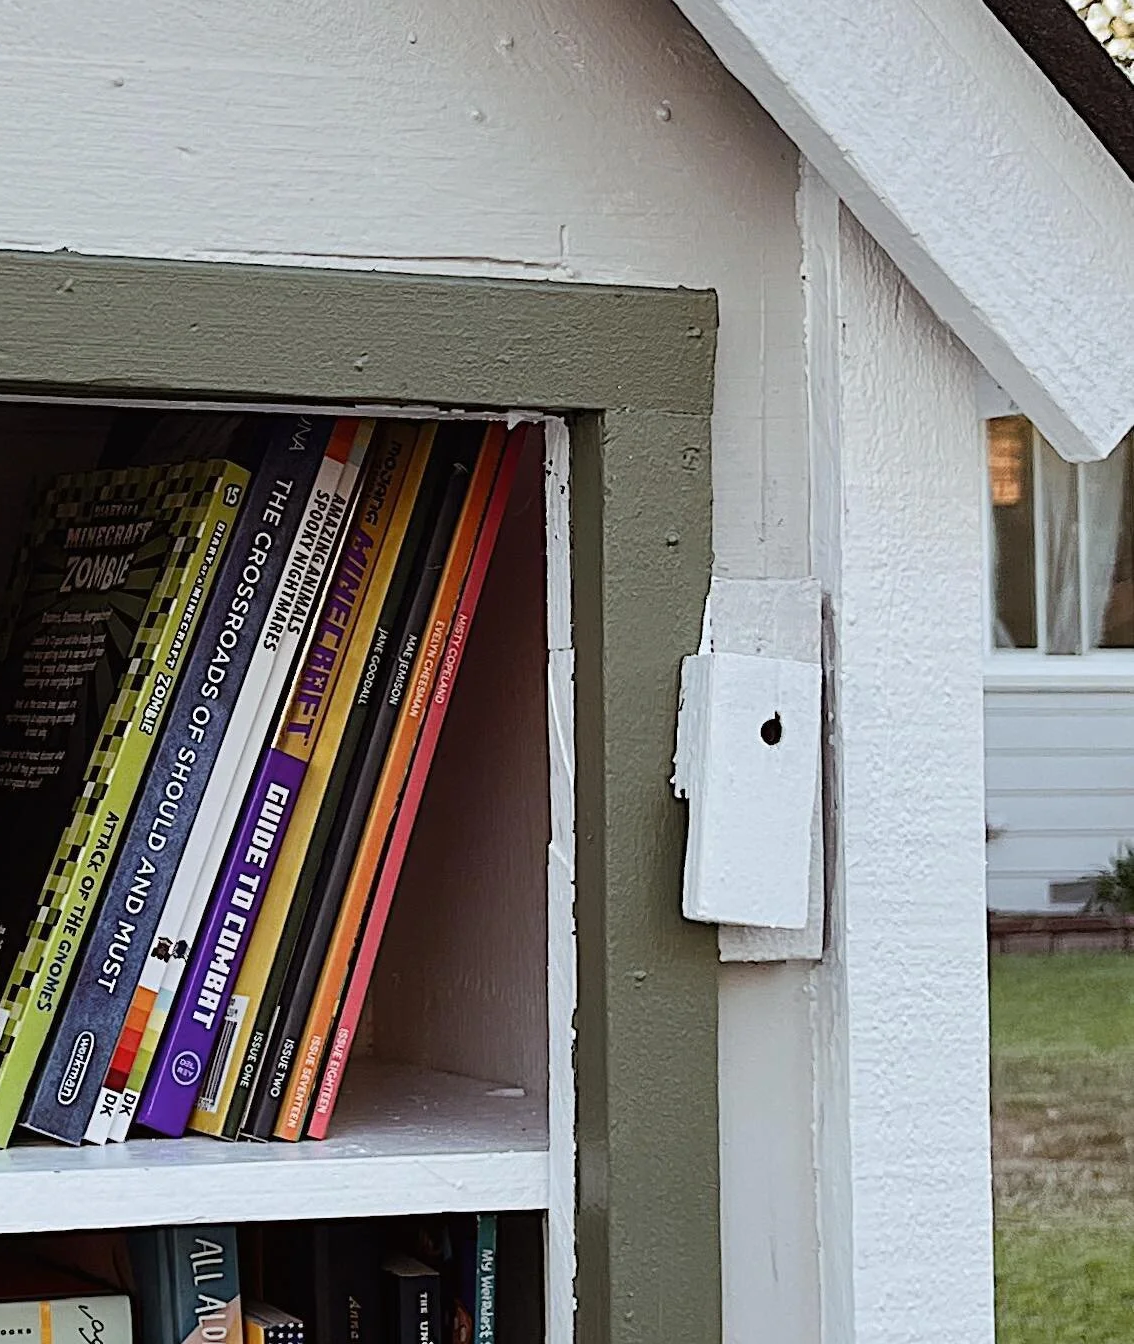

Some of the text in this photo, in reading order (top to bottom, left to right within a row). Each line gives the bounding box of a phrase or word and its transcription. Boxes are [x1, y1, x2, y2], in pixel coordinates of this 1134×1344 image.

[260, 488, 330, 653] SPOOKY NIGHTMARES
[284, 493, 346, 635] AMAZING ANIMALS
[284, 523, 376, 742] MINECRAFT
[355, 626, 389, 706] JANE GOODALL
[385, 633, 418, 706] MAE JEMISON
[407, 619, 446, 718] EVELYN CHEESMAN
[432, 612, 468, 705] MISTY COPELAND
[94, 476, 293, 994] THE CROSSROADS OF SHOULD AND MUST
[34, 810, 121, 1013] ATTACK OF THE GNOMES
[188, 781, 291, 1029] GUIDE TO COMBAT
[59, 1034, 93, 1099] workman
[238, 1030, 264, 1088] ISSUE ONE
[268, 1037, 295, 1098] ISSUE TWO
[285, 1034, 322, 1128] ISSUE SEVENTEEN
[315, 1027, 350, 1114] ISSUE EIGHTEEN
[98, 1091, 117, 1117] DK
[117, 1091, 137, 1117] DK
[188, 1236, 225, 1286] ALL
[419, 1292, 427, 1313] THE
[348, 1296, 362, 1339] Anna
